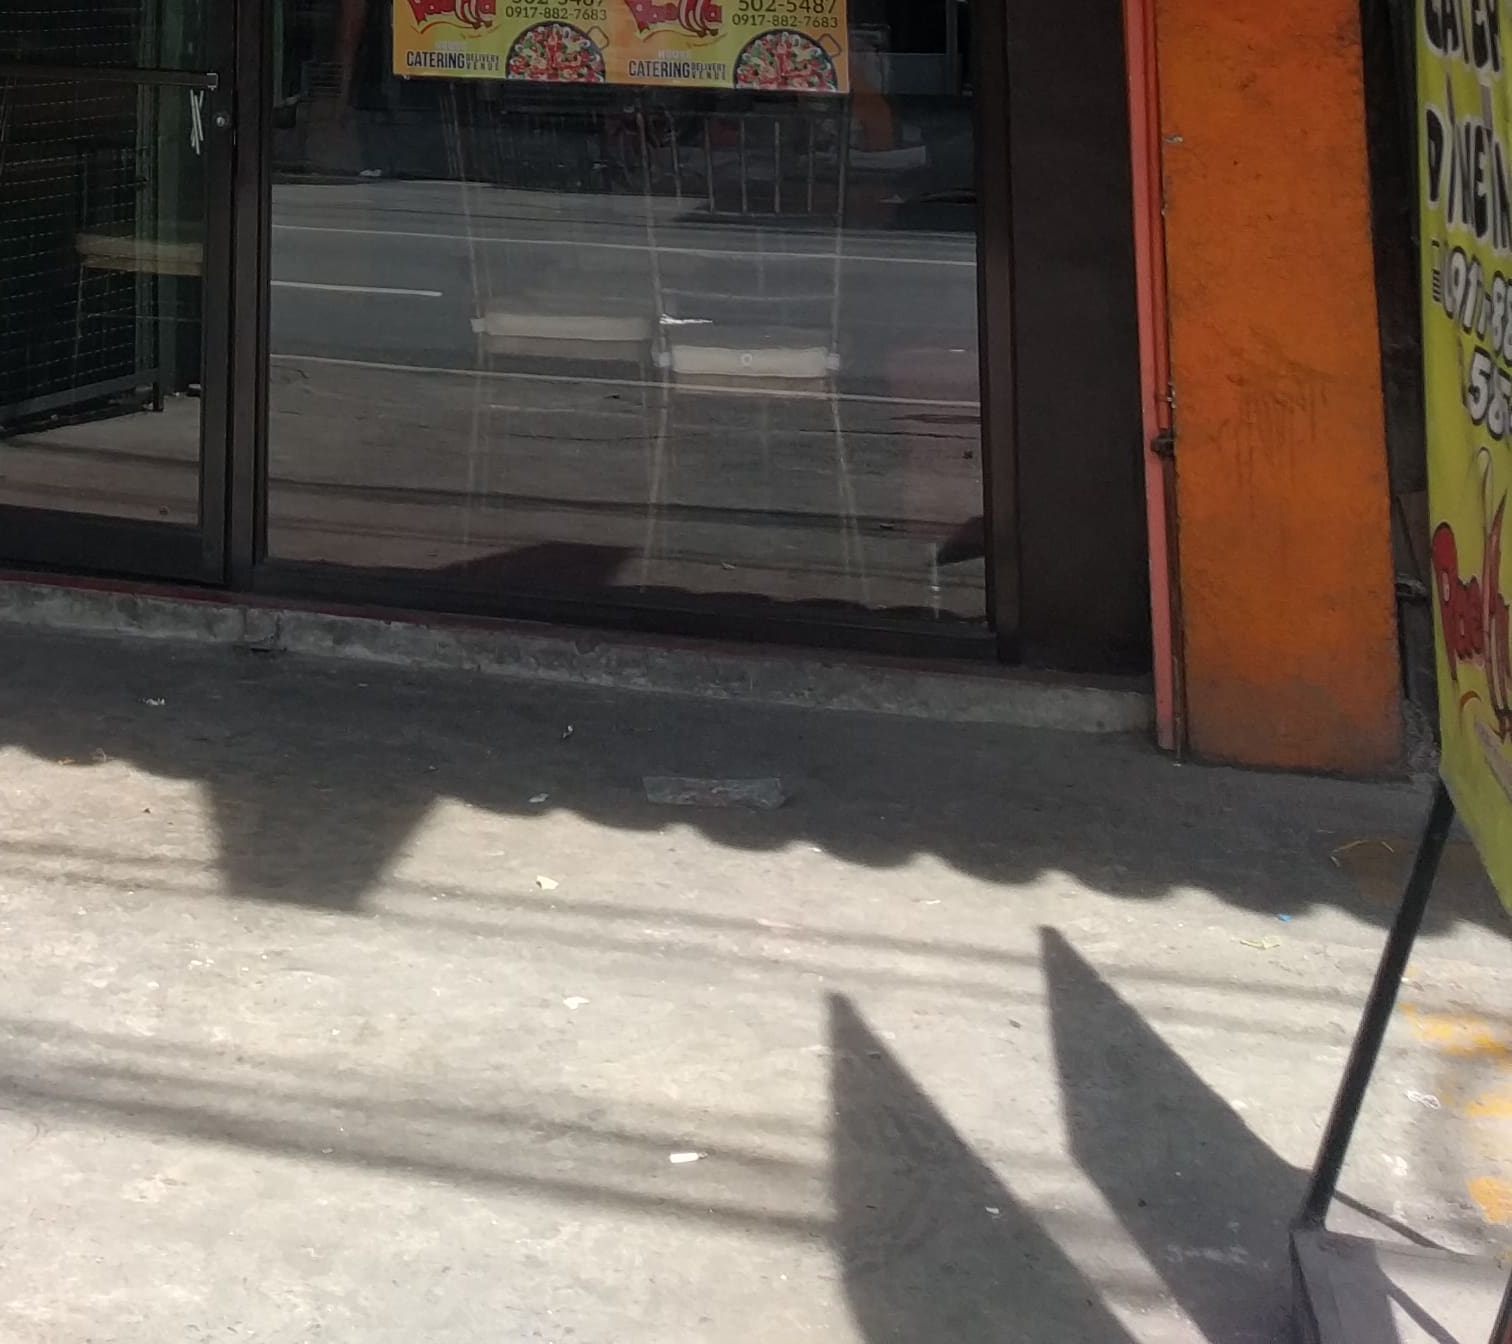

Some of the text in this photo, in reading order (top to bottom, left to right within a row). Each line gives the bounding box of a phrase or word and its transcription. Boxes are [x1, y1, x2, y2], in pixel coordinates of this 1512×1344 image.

[505, 7, 607, 20] 0917-882-7683
[732, 14, 838, 28] 0917-882-7683
[406, 51, 465, 69] CATERING
[629, 61, 690, 78] CATERING
